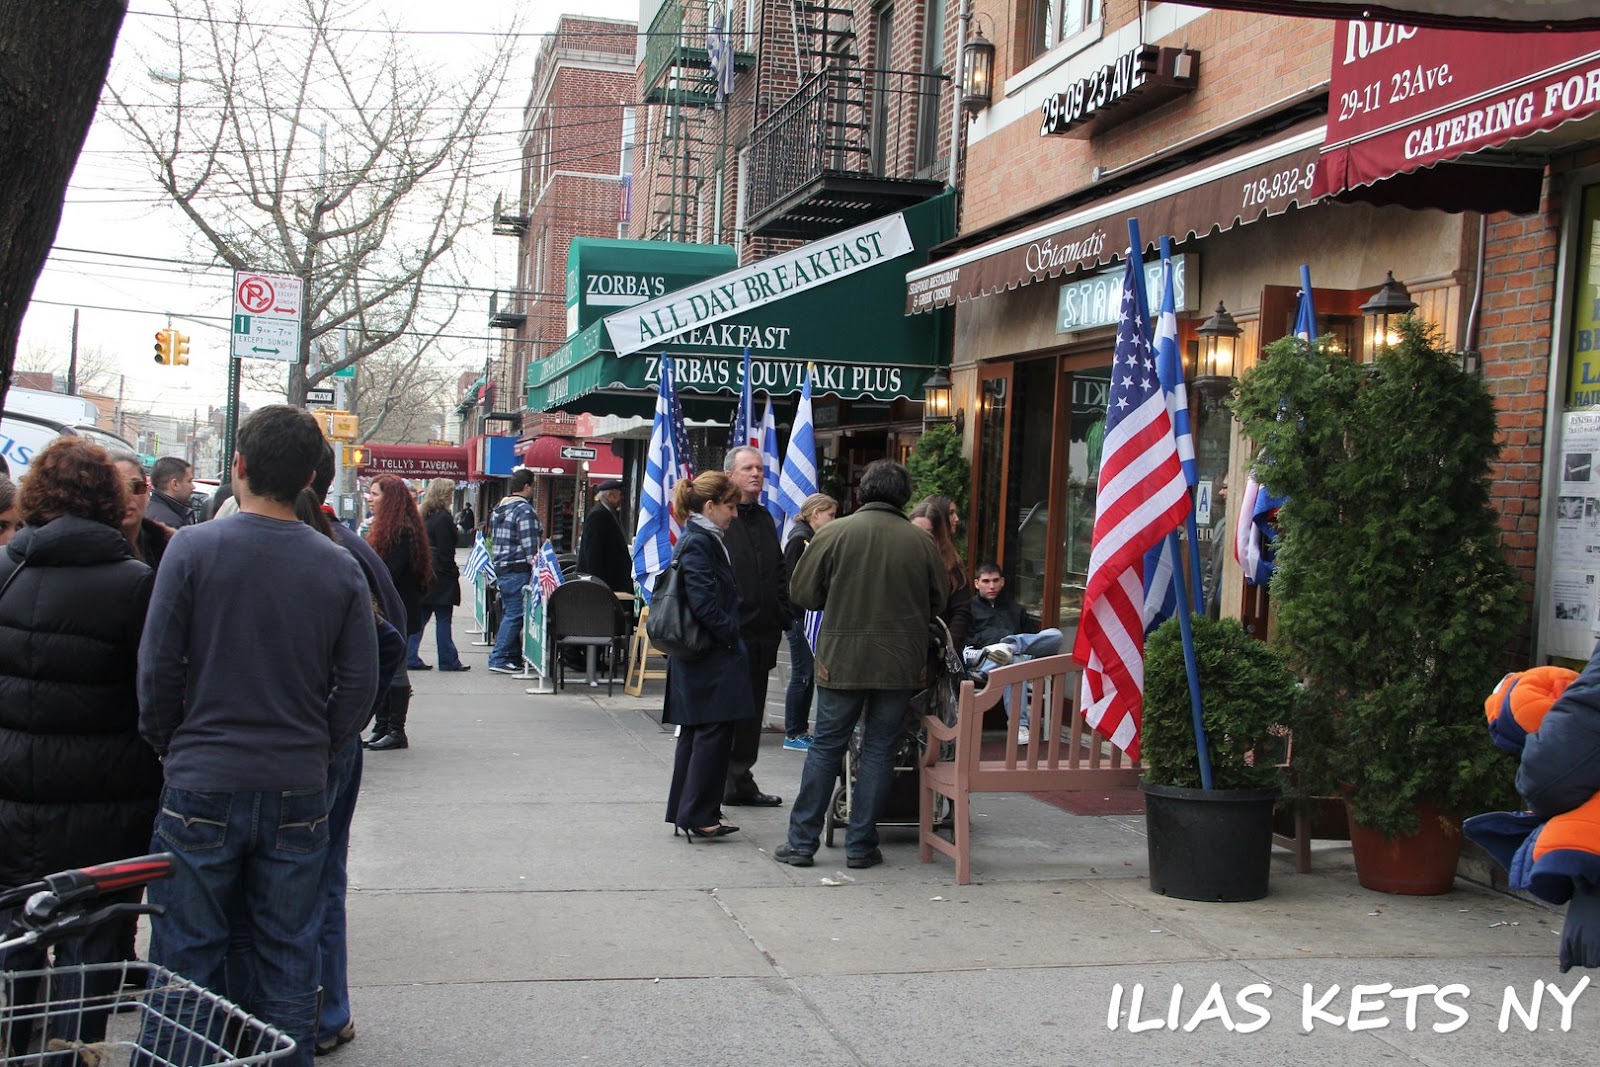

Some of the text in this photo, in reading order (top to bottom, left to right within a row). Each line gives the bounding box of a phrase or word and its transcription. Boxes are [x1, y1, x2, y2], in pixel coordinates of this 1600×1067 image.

[1040, 44, 1146, 137] 29-09 23 AVE.
[1338, 62, 1453, 122] 29-11 23Ave.
[1404, 68, 1600, 160] CATERING FOR
[1242, 162, 1317, 208] 718-932-8
[1025, 229, 1106, 273] Stamatis
[586, 274, 665, 296] ZORBA'S
[639, 303, 688, 343] ALL
[690, 282, 739, 323] DAY
[741, 231, 886, 303] BREAKFAST
[929, 268, 960, 289] RESTAURANT
[1064, 260, 1184, 328] STAMTS
[240, 316, 245, 333] 1
[239, 336, 293, 347] EXCEPT SUNDAY
[851, 365, 902, 392] PLUS
[314, 392, 329, 400] WAY
[380, 458, 459, 470] TELLY'S TAVERNA
[1199, 486, 1208, 512] A
